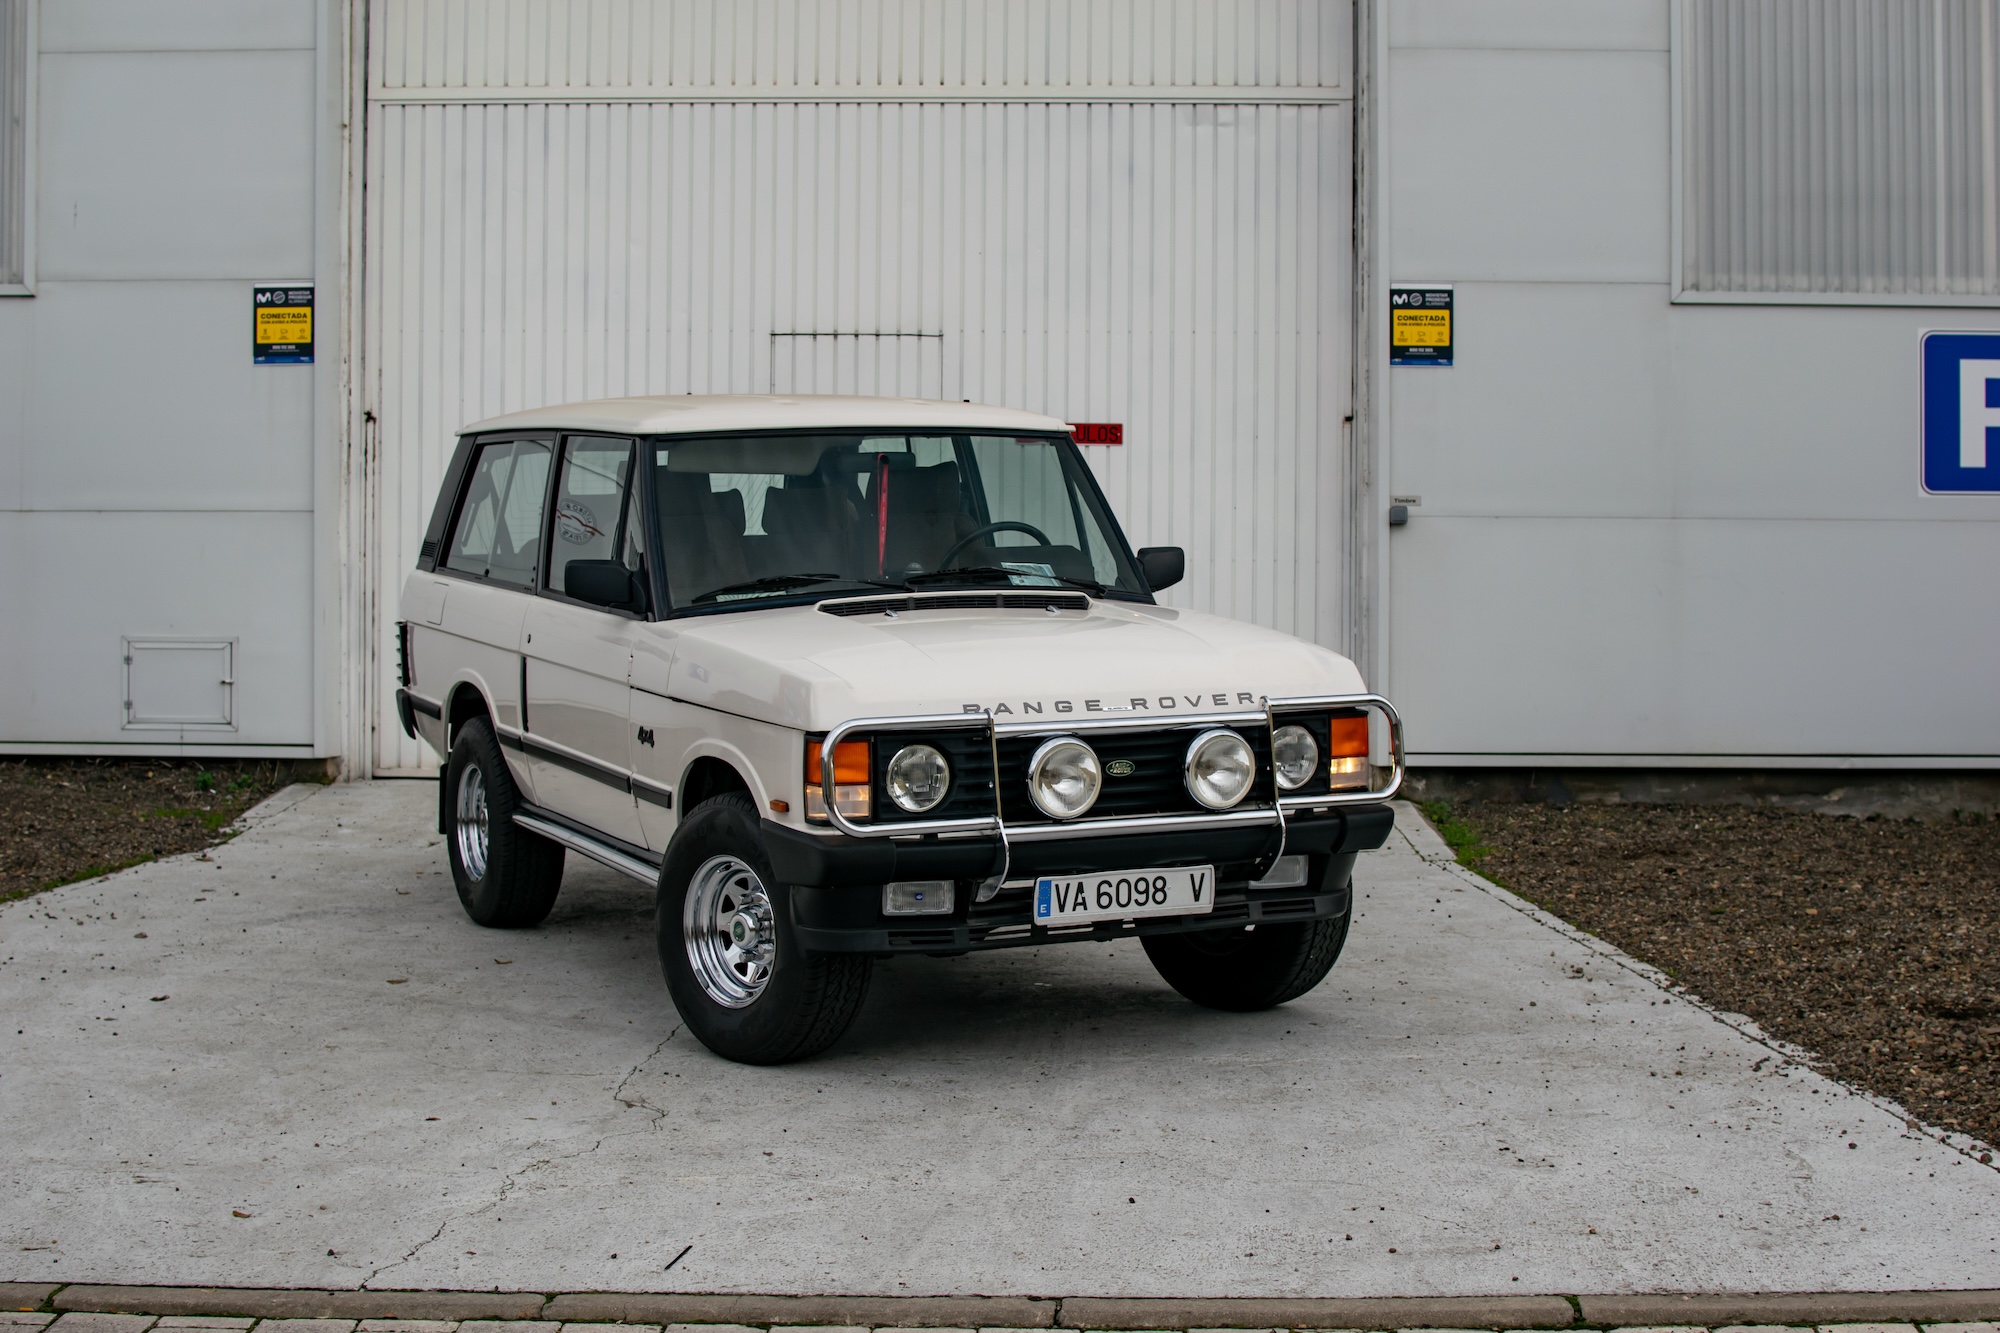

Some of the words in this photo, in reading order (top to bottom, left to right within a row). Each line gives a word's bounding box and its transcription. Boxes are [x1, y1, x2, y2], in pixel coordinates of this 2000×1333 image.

[1076, 426, 1118, 442] ULOS
[962, 699, 1103, 715] RANGE
[1130, 692, 1254, 710] ROVER
[1055, 881, 1088, 913] VA
[1096, 875, 1167, 910] 6098
[1189, 873, 1205, 902] V
[1040, 904, 1047, 913] E
